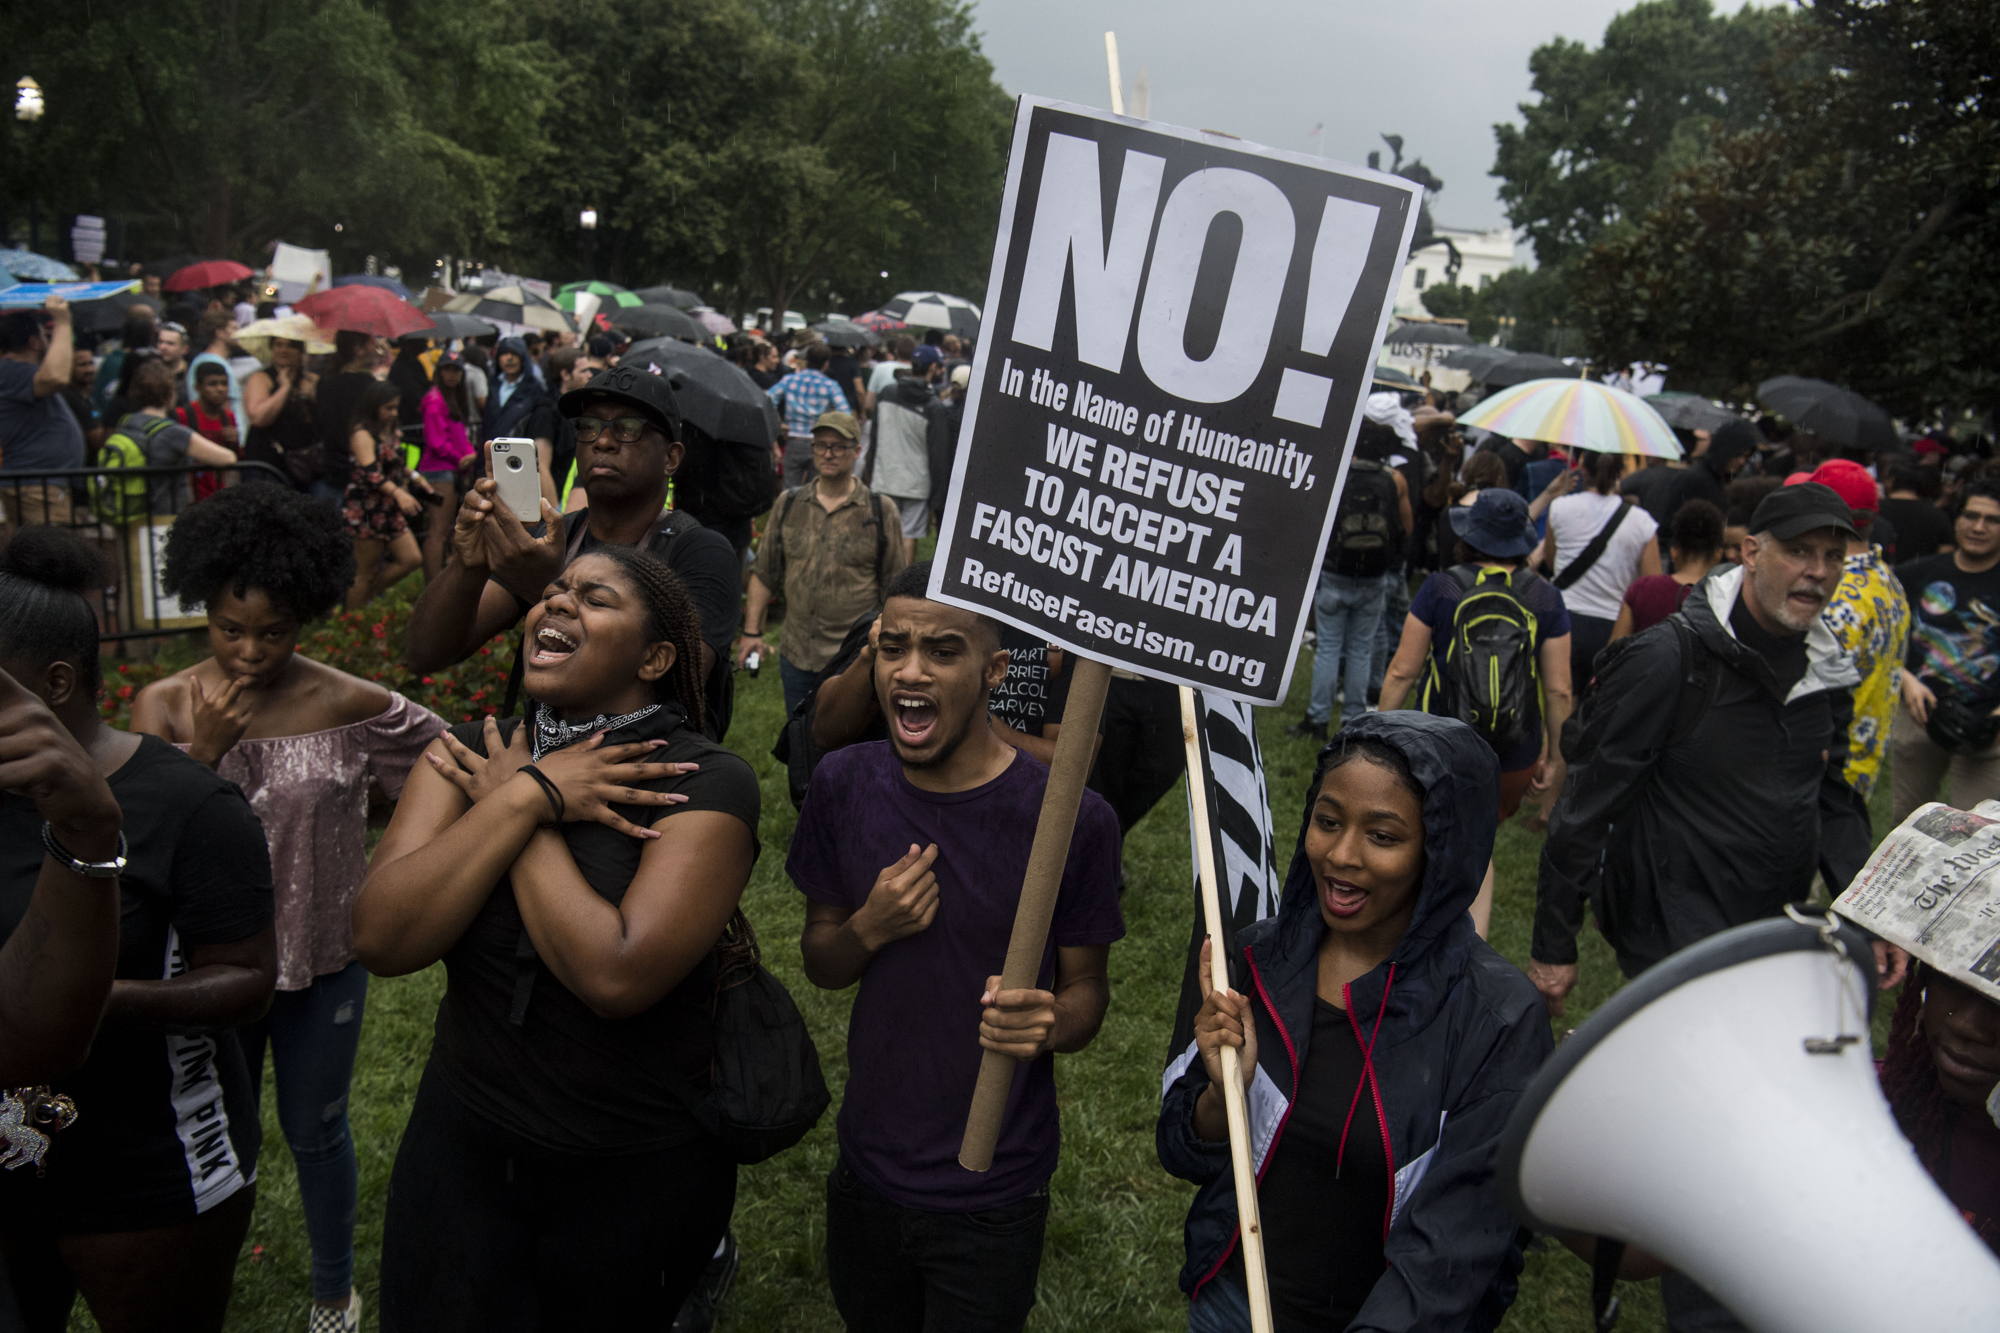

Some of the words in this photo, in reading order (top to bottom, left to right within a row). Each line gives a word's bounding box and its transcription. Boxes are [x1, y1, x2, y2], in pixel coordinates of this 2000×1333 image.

[1011, 131, 1381, 428] NO!
[999, 358, 1024, 394] In
[1030, 367, 1068, 411] the
[1072, 380, 1139, 436] Name
[1143, 409, 1176, 446] of
[1177, 414, 1316, 491] Humanity,
[1046, 422, 1097, 478] WE
[1099, 444, 1245, 522] REFUSE
[1024, 467, 1064, 516] TO
[1066, 487, 1212, 565] ACCEPT
[1212, 533, 1243, 576] A
[970, 501, 1103, 583] FASCIST
[1102, 553, 1277, 637] AMERICA
[960, 556, 1266, 687] RefuseFascism.org
[1001, 647, 1047, 661] MART
[990, 682, 1048, 699] ALCOL
[1006, 664, 1050, 680] RRIET
[1914, 875, 1956, 910] The
[177, 1035, 212, 1094] INK
[190, 1101, 231, 1182] PINK
